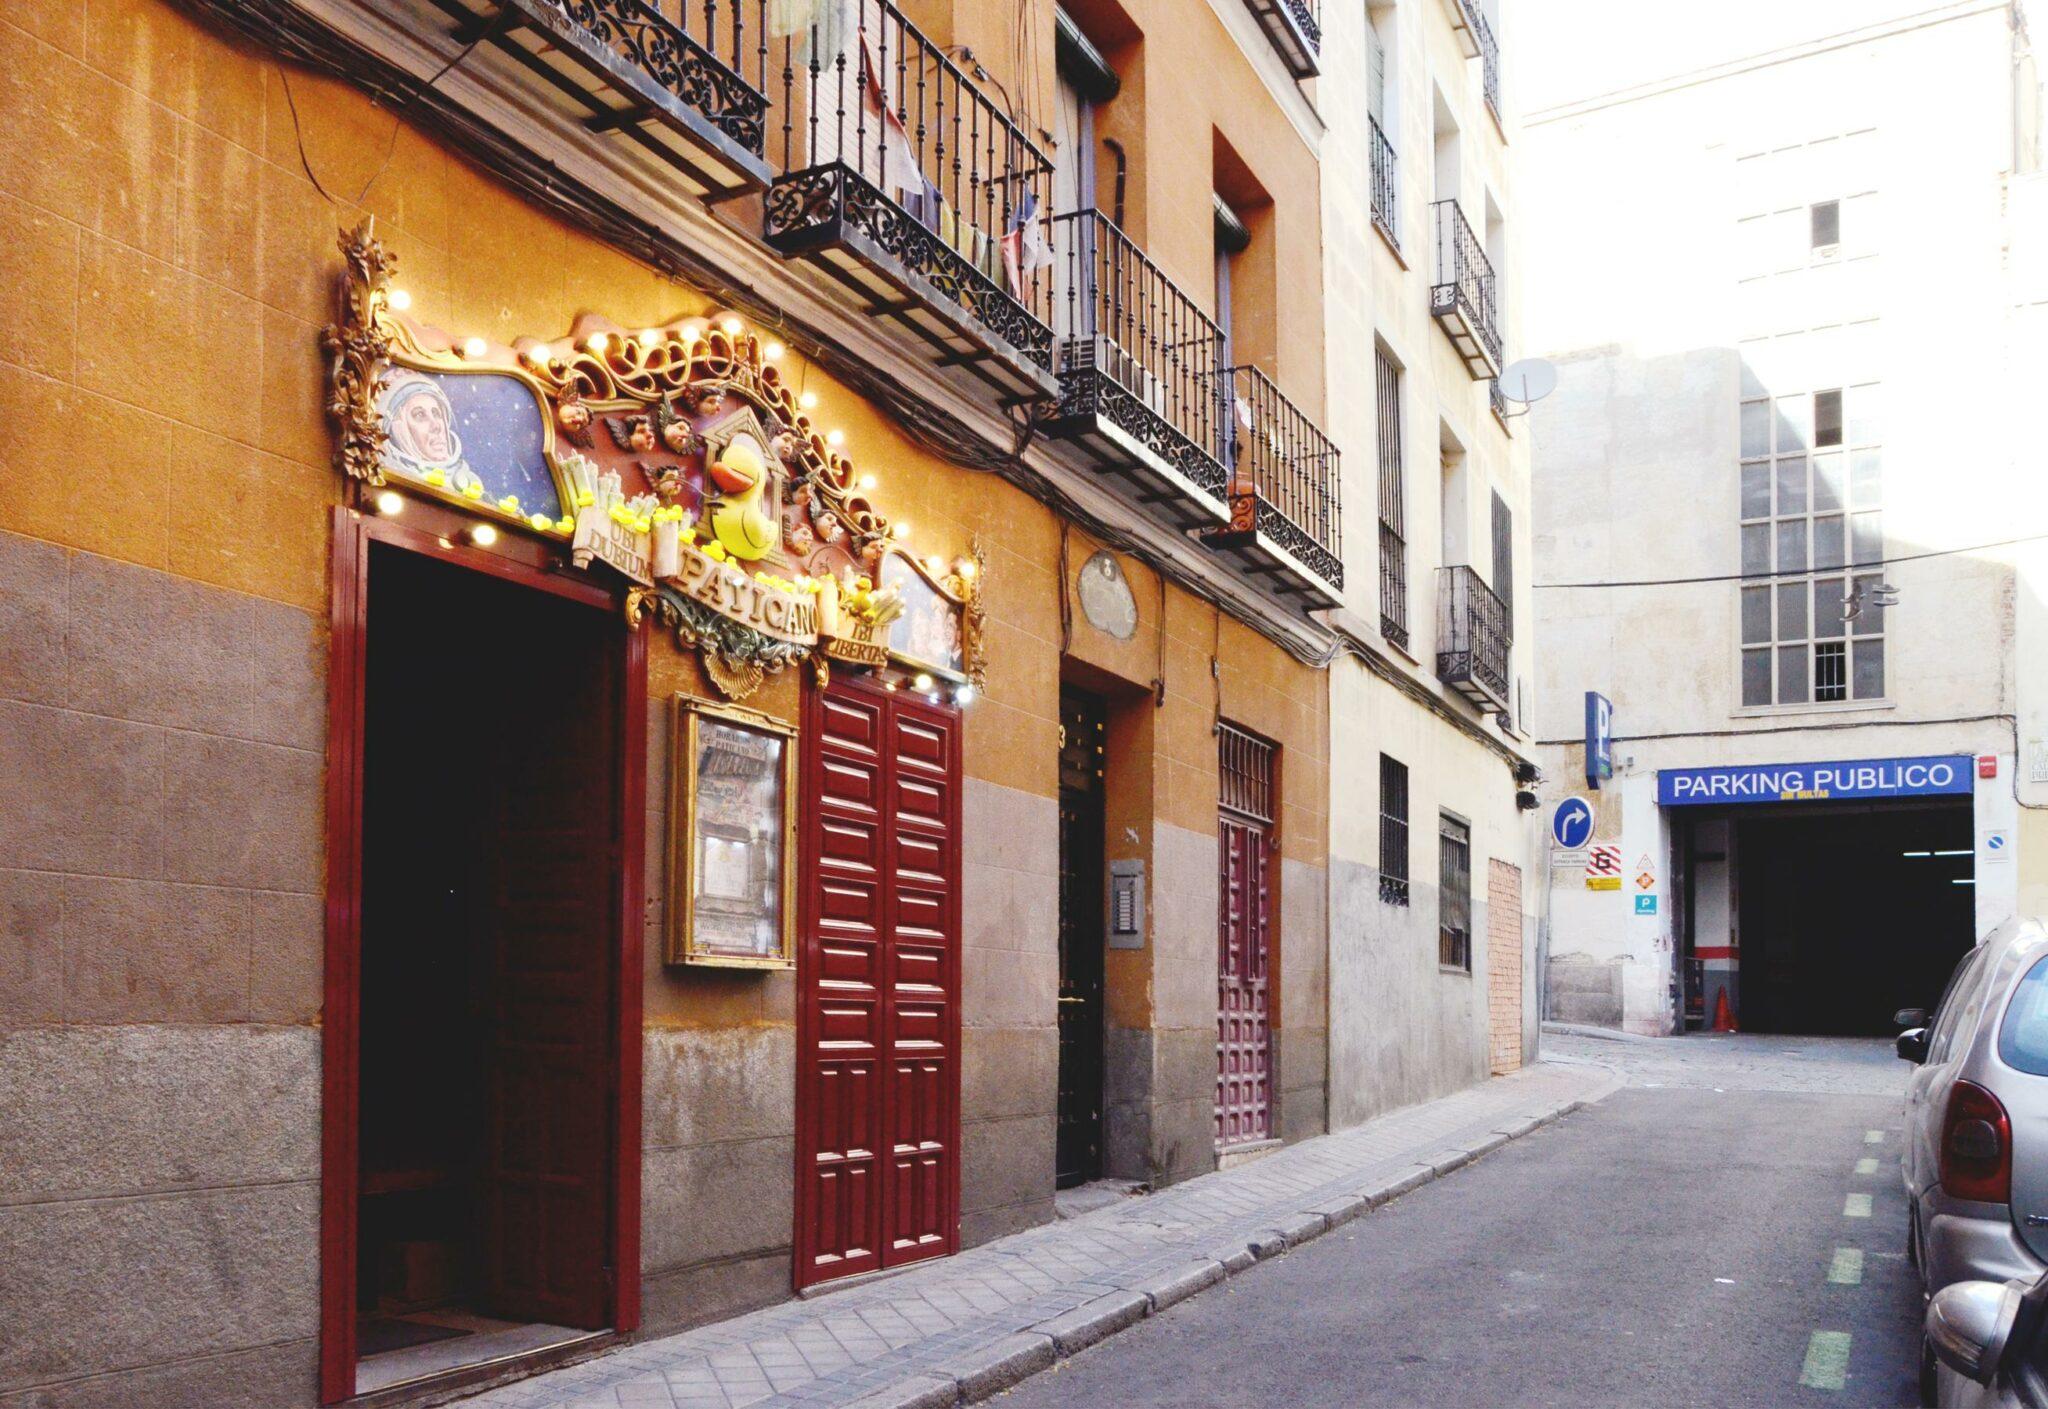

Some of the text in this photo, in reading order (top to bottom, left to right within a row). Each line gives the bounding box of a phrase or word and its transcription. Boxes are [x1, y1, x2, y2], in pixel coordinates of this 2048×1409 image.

[609, 518, 637, 552] UBI
[674, 549, 818, 637] PATICANO
[851, 622, 874, 642] IBI
[1598, 697, 1610, 758] P
[1673, 763, 1954, 798] PARKING PUBLICO
[1596, 853, 1611, 870] G
[1641, 897, 1650, 908] P
